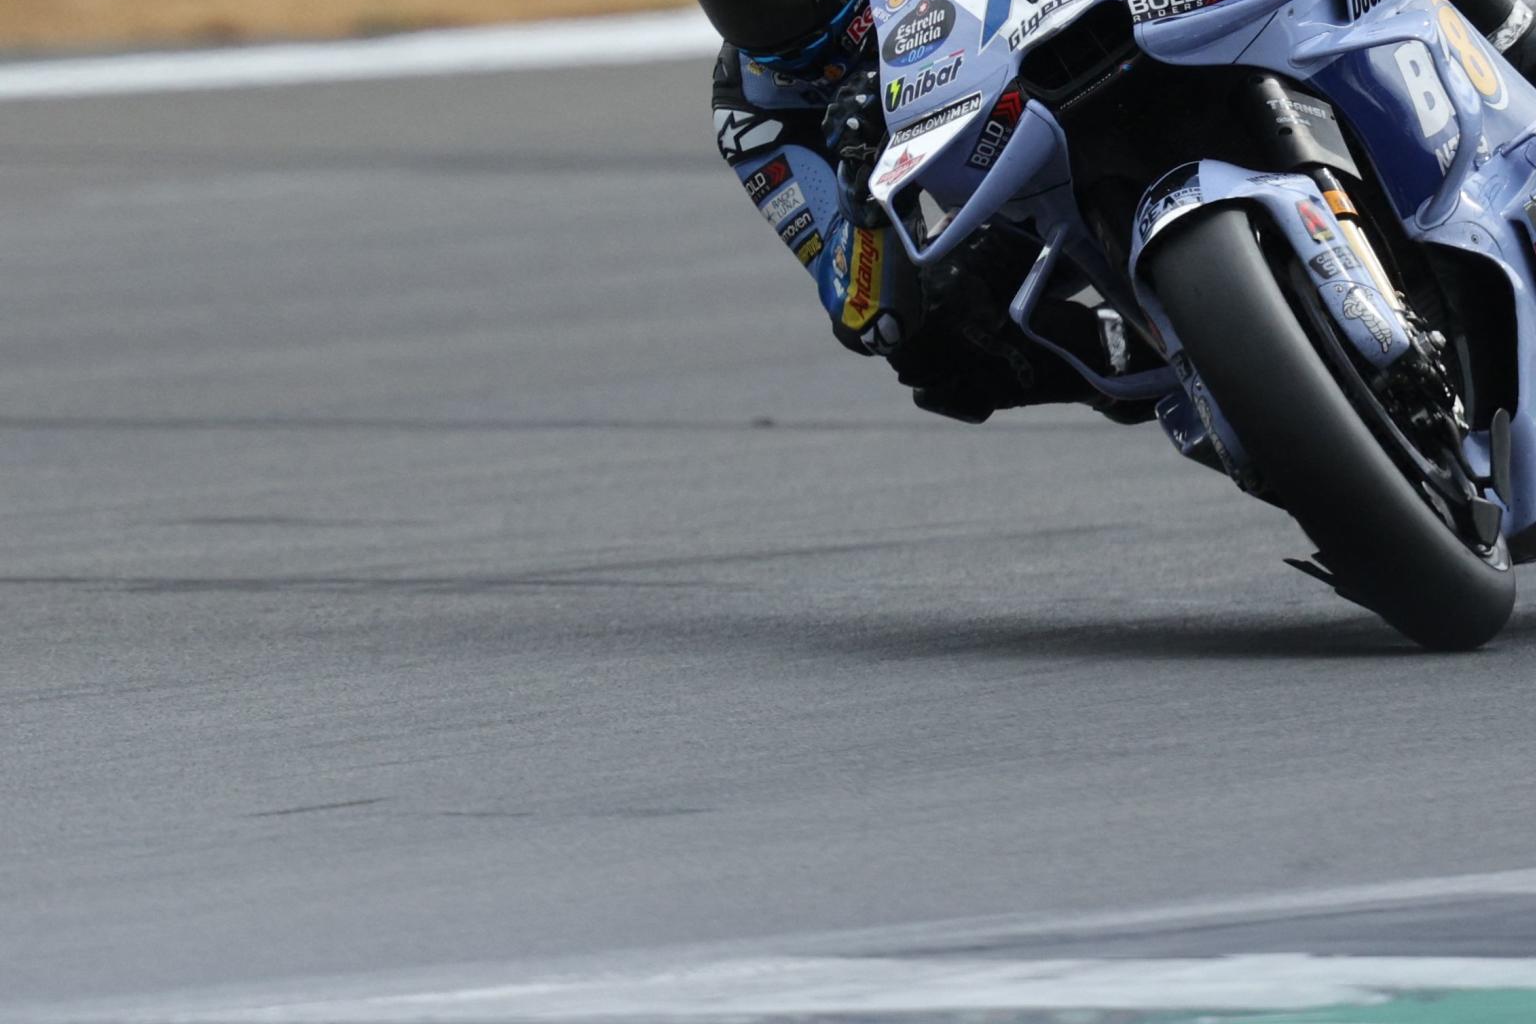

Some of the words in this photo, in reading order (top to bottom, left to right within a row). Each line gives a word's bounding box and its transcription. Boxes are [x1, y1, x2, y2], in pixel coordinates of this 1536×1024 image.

[895, 7, 945, 41] Estrella
[1132, 0, 1204, 24] RIDERS
[895, 26, 942, 55] Galicia
[886, 56, 964, 112] Unibat
[1393, 0, 1509, 139] B8
[911, 113, 947, 138] GLOW
[949, 95, 980, 119] MEN
[970, 120, 1005, 167] BOLD
